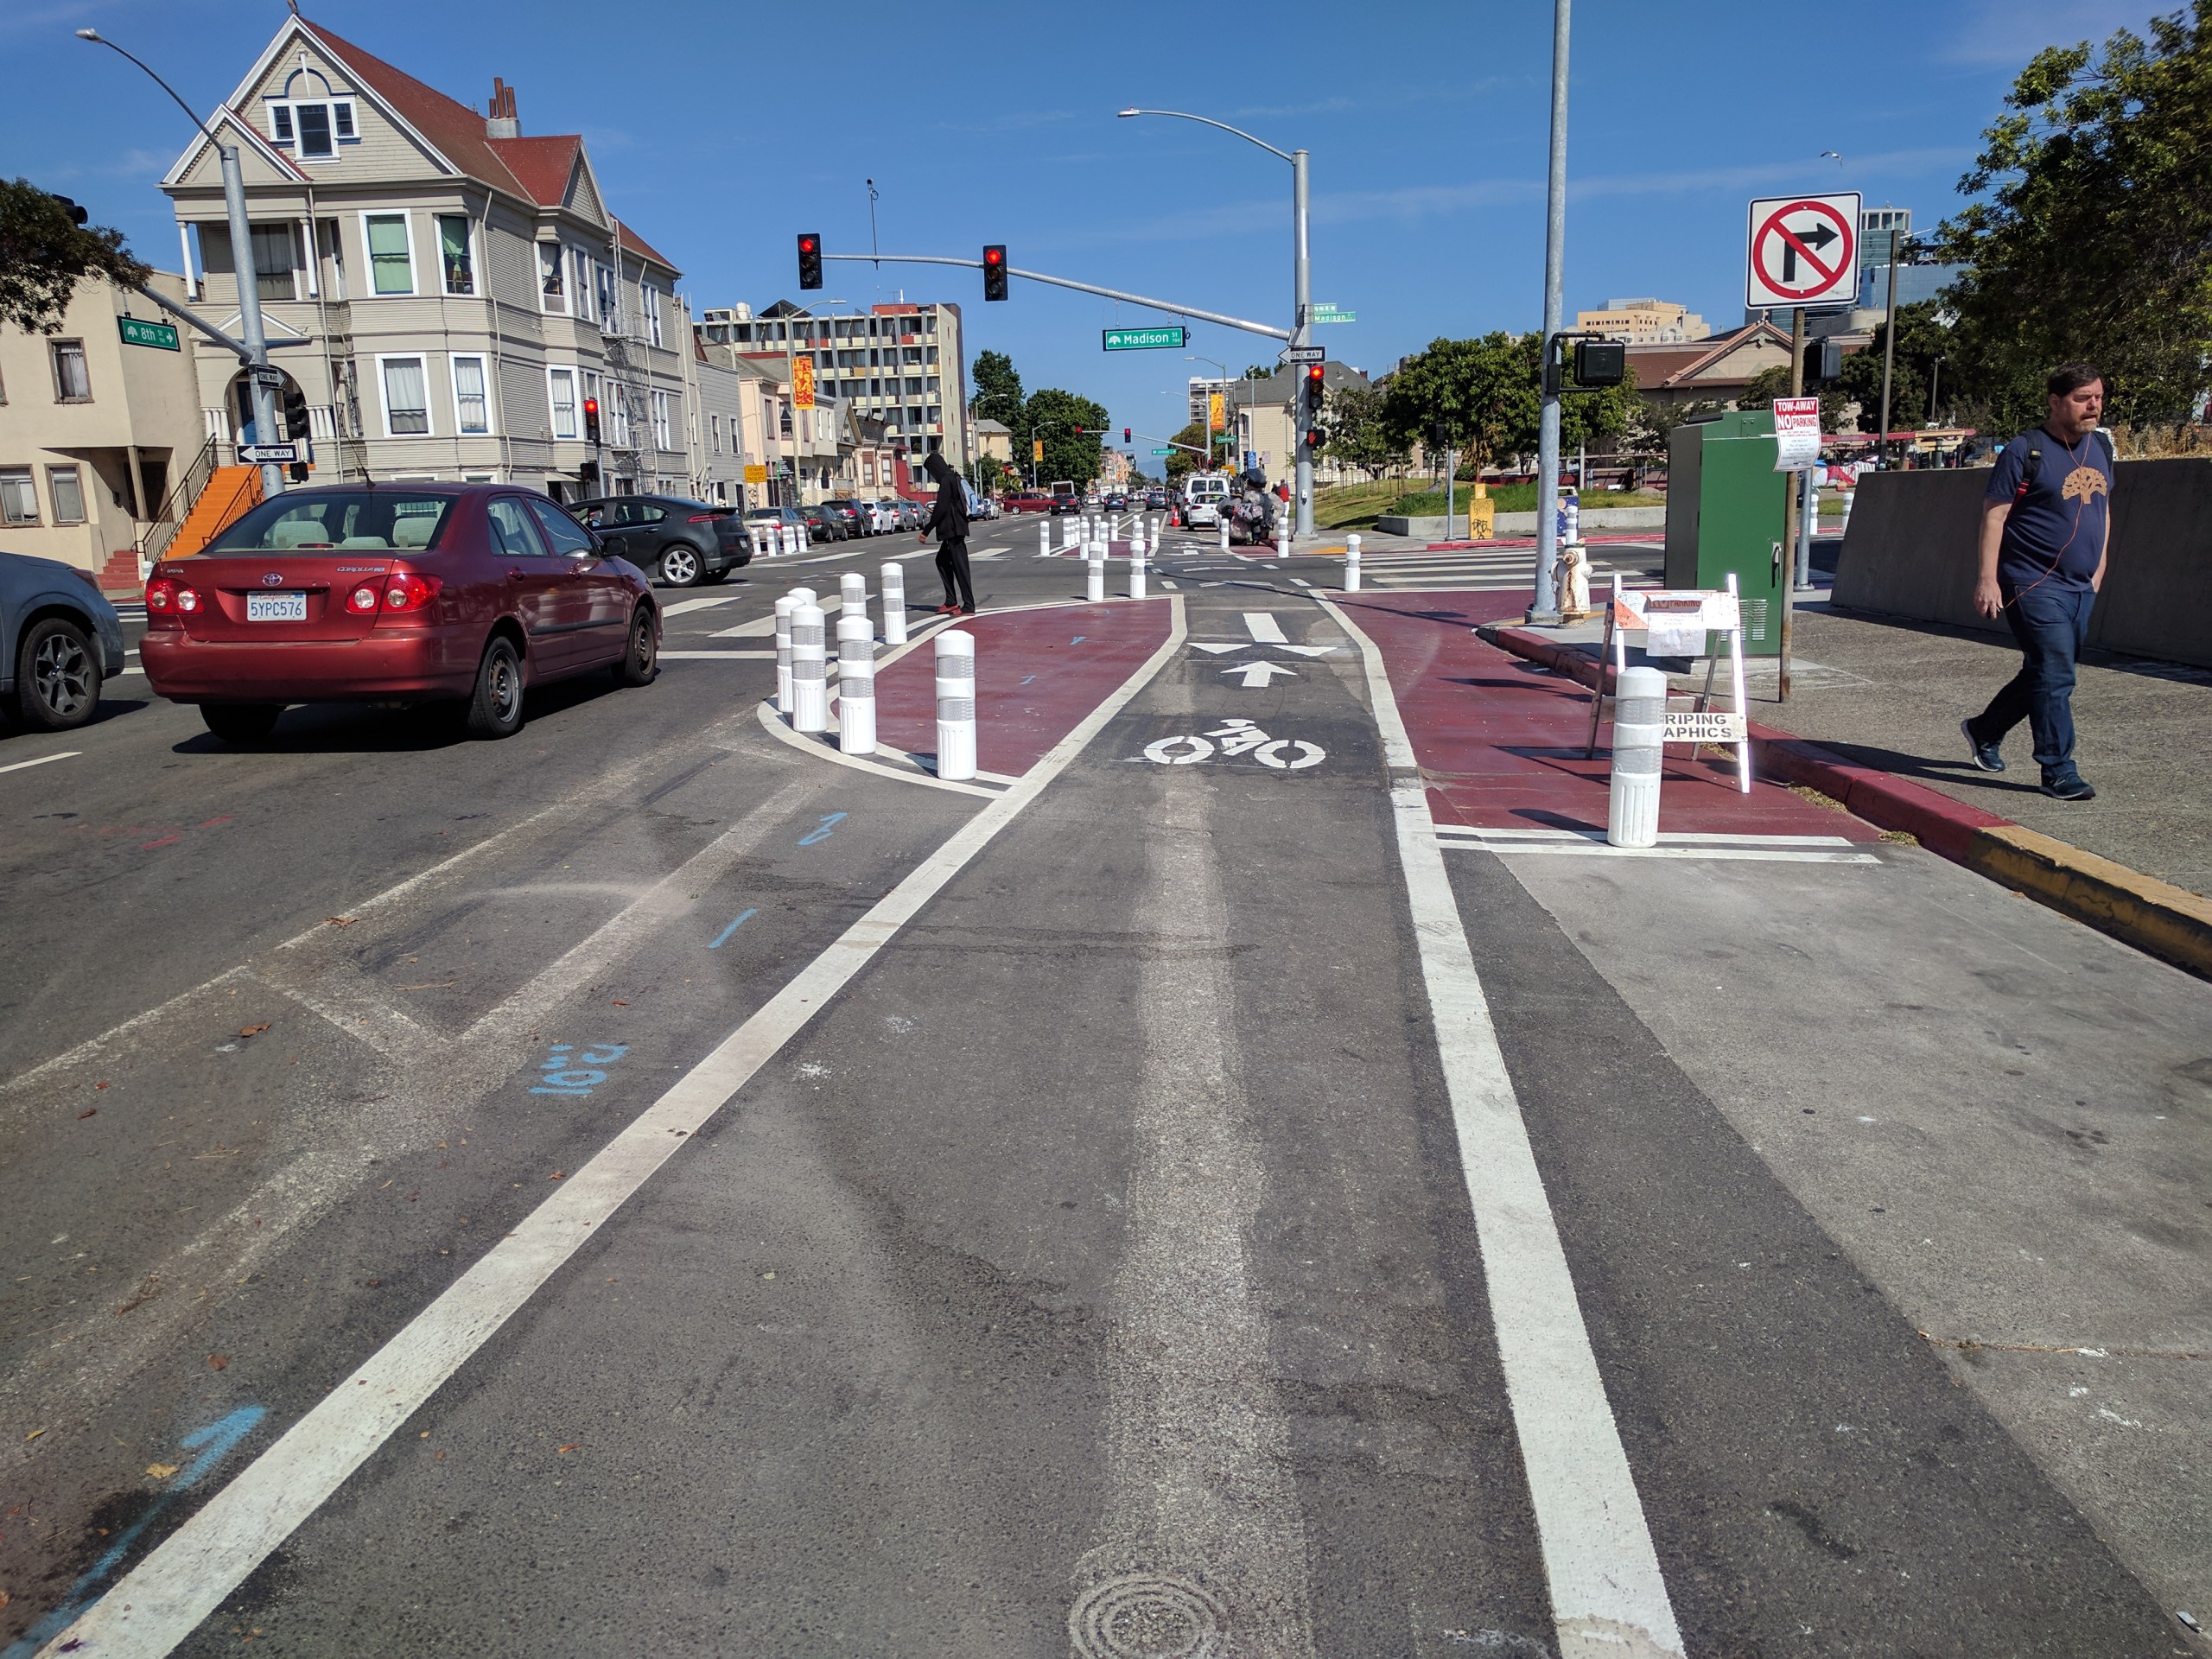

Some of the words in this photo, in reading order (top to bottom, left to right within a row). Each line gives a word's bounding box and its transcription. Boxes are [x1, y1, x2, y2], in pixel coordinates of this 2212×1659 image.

[140, 327, 156, 341] 8th
[1123, 333, 1169, 345] Madison
[259, 372, 269, 381] ONE
[1777, 400, 1816, 412] TOW-AWAY
[1777, 415, 1792, 429] NO
[1792, 417, 1817, 428] PARKING
[251, 601, 302, 616] 5YPC576
